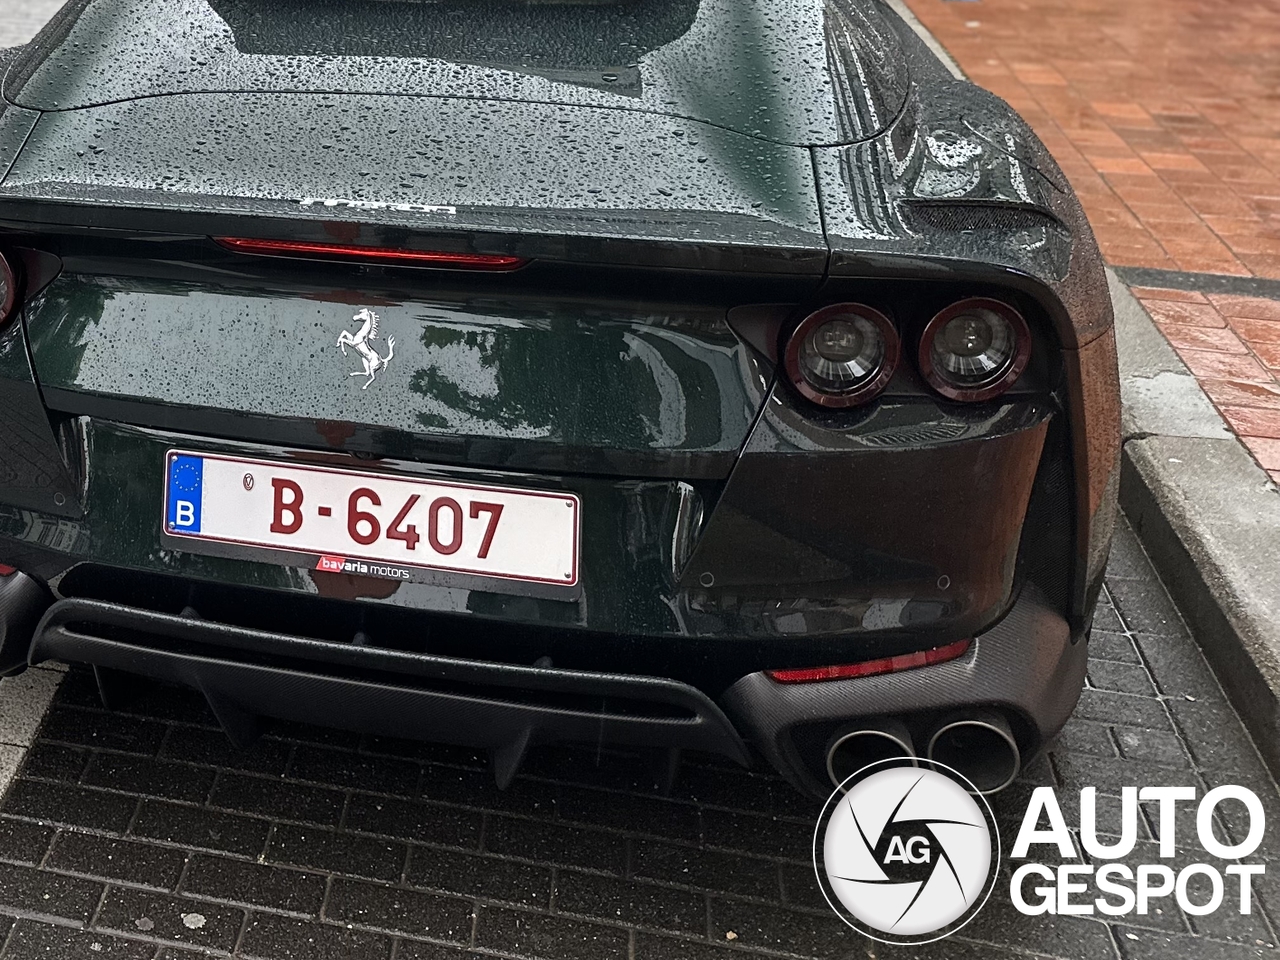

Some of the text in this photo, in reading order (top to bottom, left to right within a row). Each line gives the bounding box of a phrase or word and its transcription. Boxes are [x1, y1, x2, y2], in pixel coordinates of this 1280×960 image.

[175, 499, 195, 527] B
[270, 477, 505, 559] B-6407
[322, 557, 410, 579] bavaria motors
